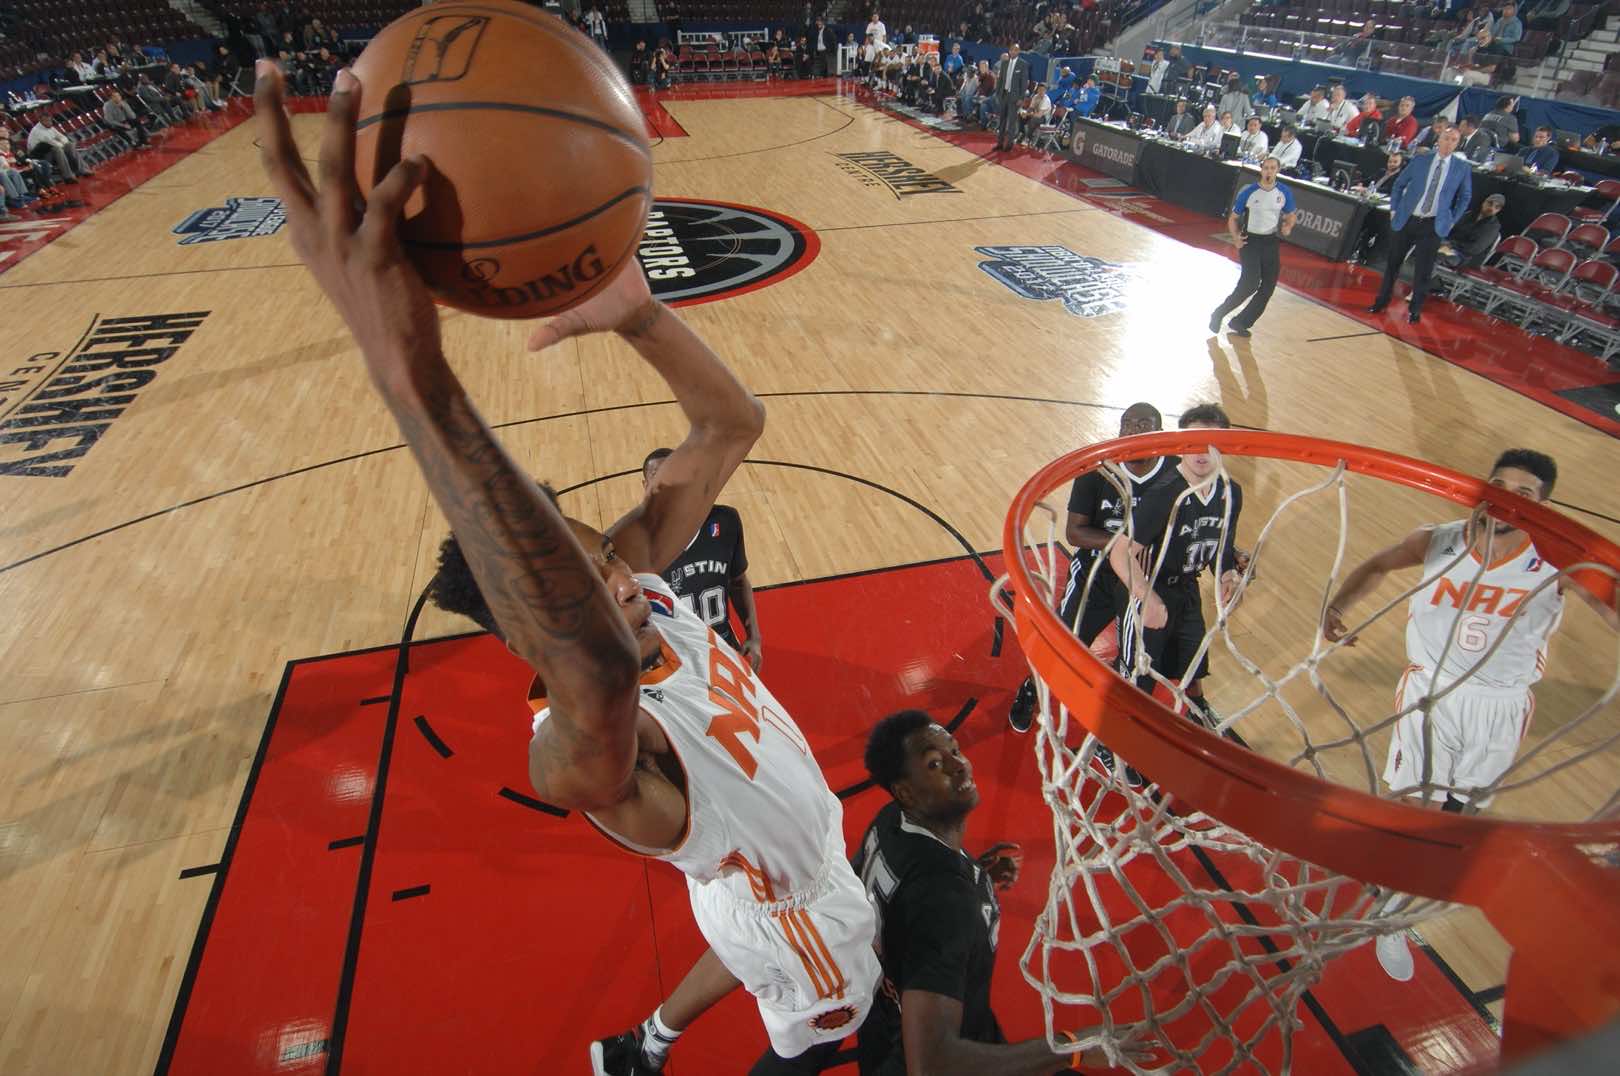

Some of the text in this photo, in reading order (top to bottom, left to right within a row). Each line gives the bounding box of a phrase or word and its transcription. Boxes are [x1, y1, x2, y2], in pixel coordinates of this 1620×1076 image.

[1092, 143, 1136, 167] GATORADE
[1295, 208, 1343, 238] ORADE
[468, 243, 607, 306] DING
[0, 352, 61, 406] CEN
[0, 310, 212, 478] HERSHEY
[1430, 575, 1531, 620] NAZ
[1456, 614, 1490, 653] 6
